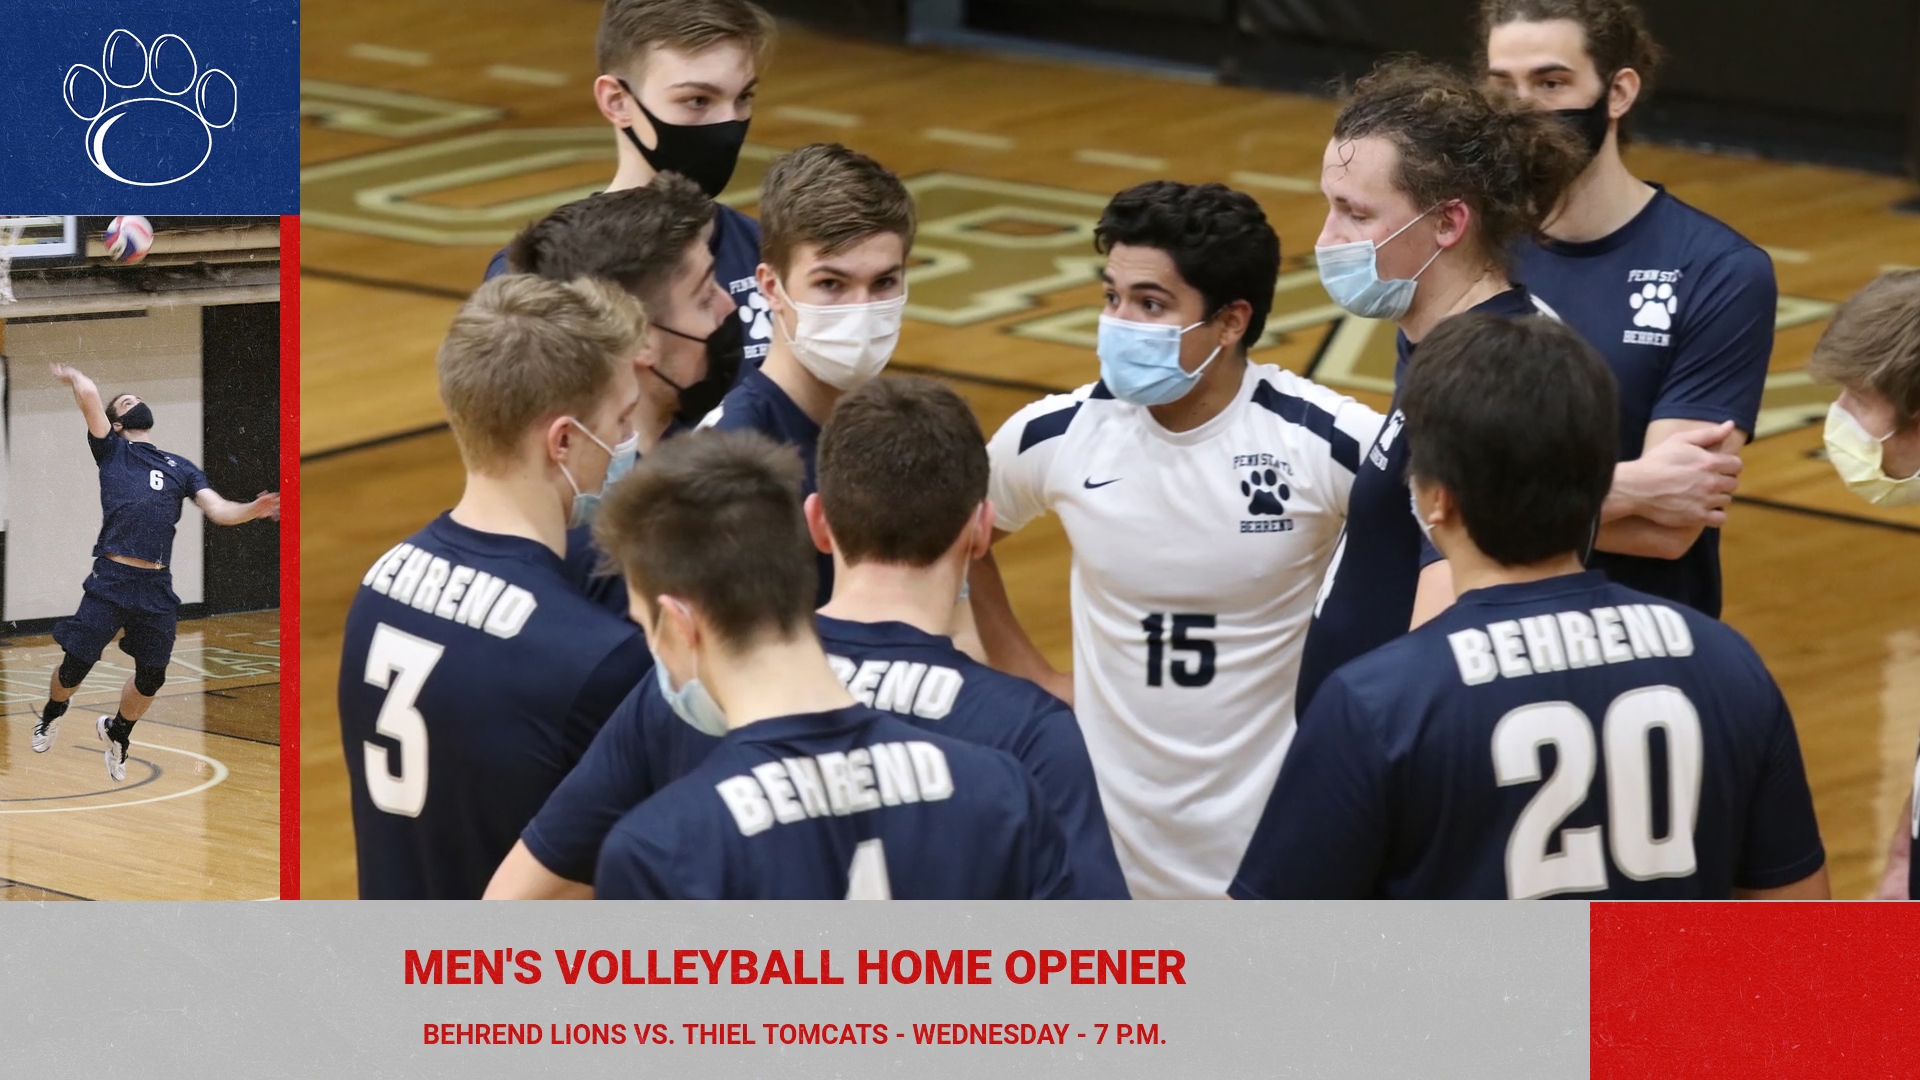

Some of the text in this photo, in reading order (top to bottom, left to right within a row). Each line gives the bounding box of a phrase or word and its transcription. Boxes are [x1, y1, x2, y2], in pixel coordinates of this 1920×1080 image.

[1627, 269, 1660, 283] PENN
[1622, 330, 1671, 347] BEHREN
[150, 470, 164, 490] 6
[1240, 519, 1294, 533] BEHREND
[1141, 613, 1217, 689] 15
[1447, 604, 1694, 686] BEHREND
[363, 622, 446, 818] 3
[715, 741, 955, 837] BEHREND
[1491, 684, 1703, 900] 20
